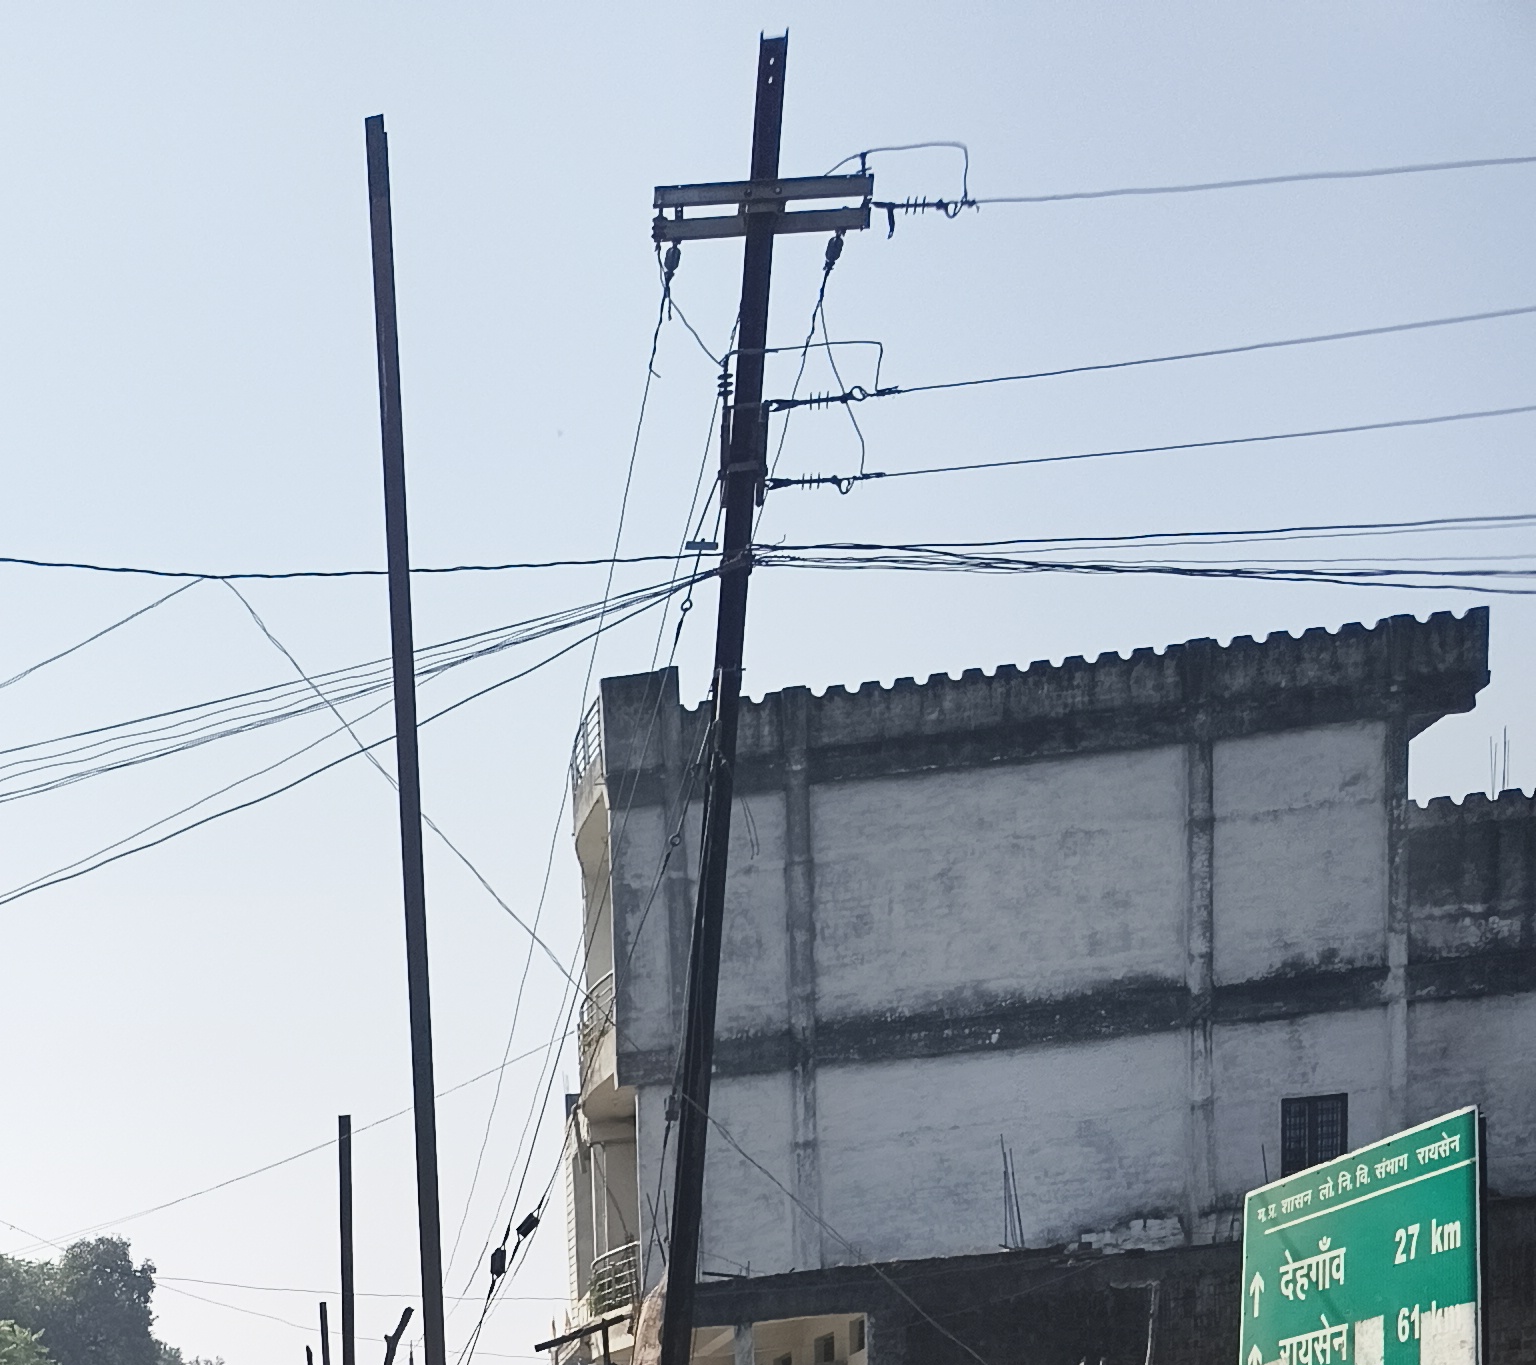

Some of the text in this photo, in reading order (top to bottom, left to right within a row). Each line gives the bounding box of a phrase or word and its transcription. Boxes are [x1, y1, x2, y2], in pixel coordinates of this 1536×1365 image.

[1281, 1190, 1312, 1213] शासन
[1374, 1158, 1408, 1179] संभाग
[1416, 1132, 1460, 1165] रायसेन
[1279, 1218, 1461, 1300] देहगाँव 27 km
[1398, 1304, 1420, 1342] 61
